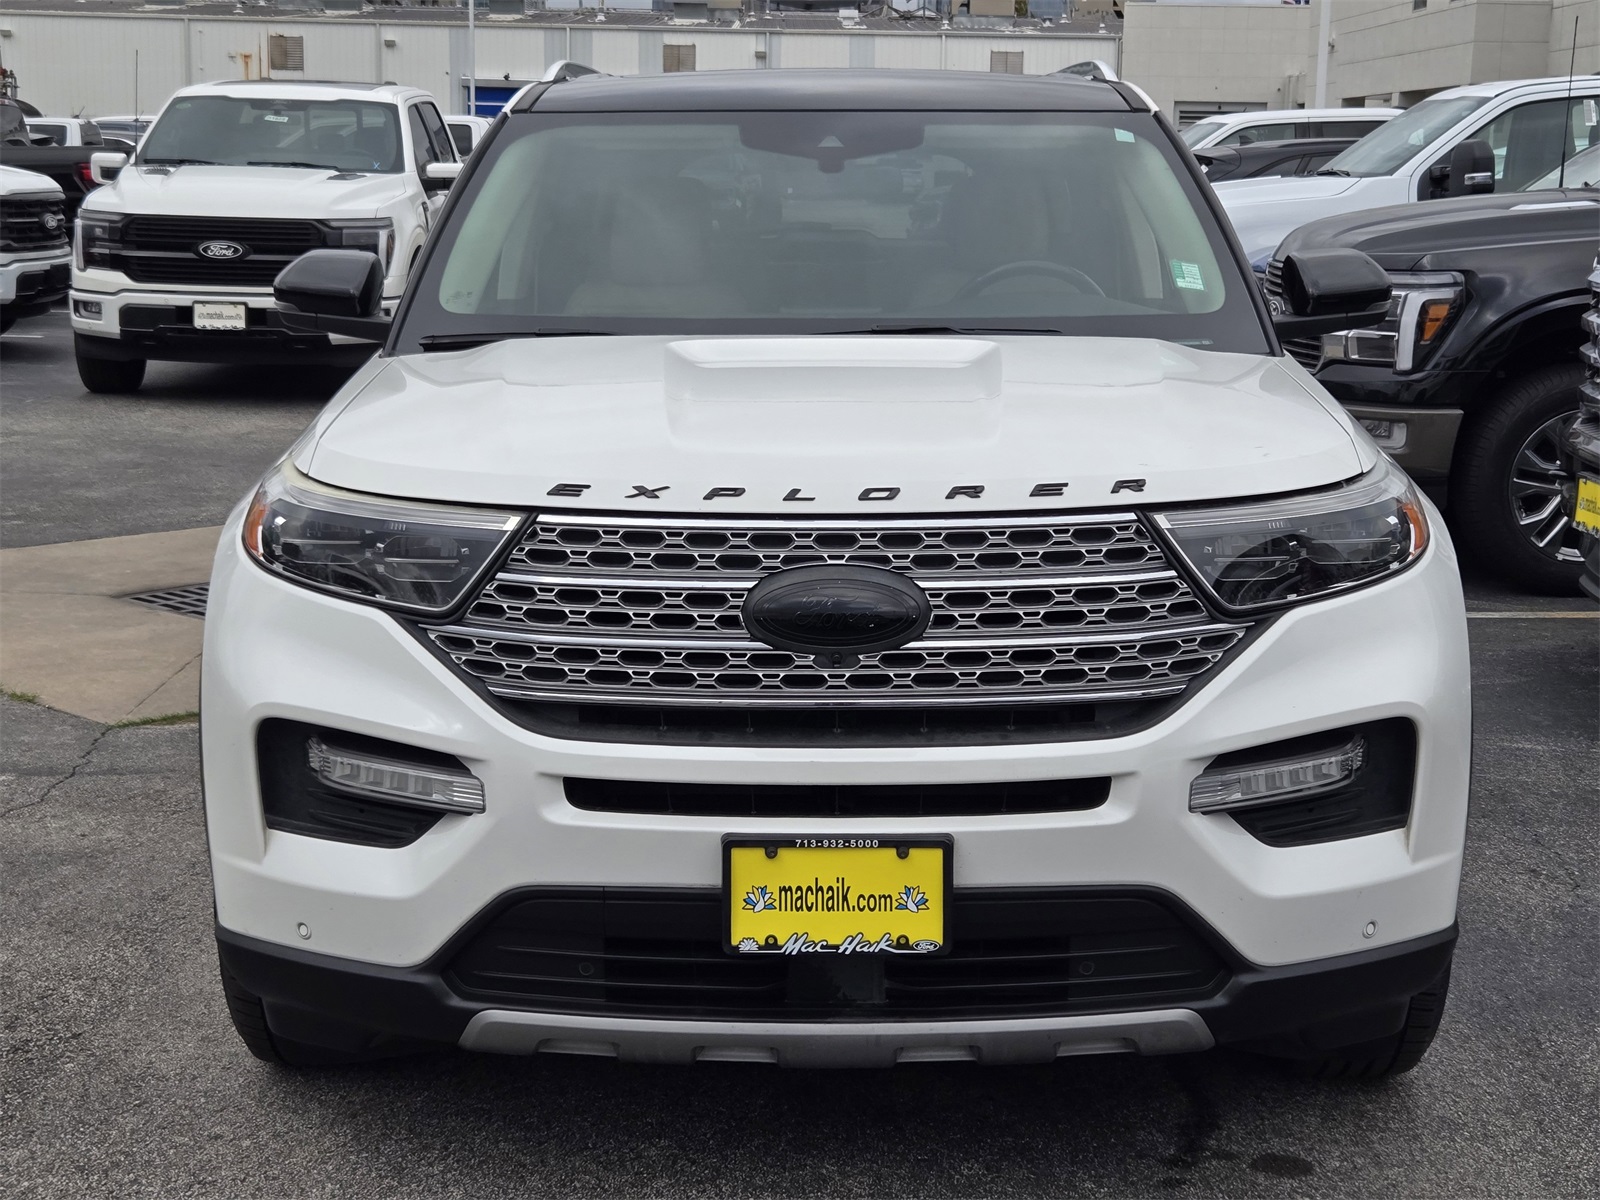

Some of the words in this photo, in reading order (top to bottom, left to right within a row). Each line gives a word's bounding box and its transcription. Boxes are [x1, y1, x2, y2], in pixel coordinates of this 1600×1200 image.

[207, 244, 235, 256] Ford
[546, 478, 1147, 502] EXPLORER
[795, 839, 879, 848] 713-932-5000
[778, 877, 893, 912] machaik.com
[781, 932, 836, 955] Mac
[838, 932, 895, 954] Haik
[917, 942, 936, 950] Ford
